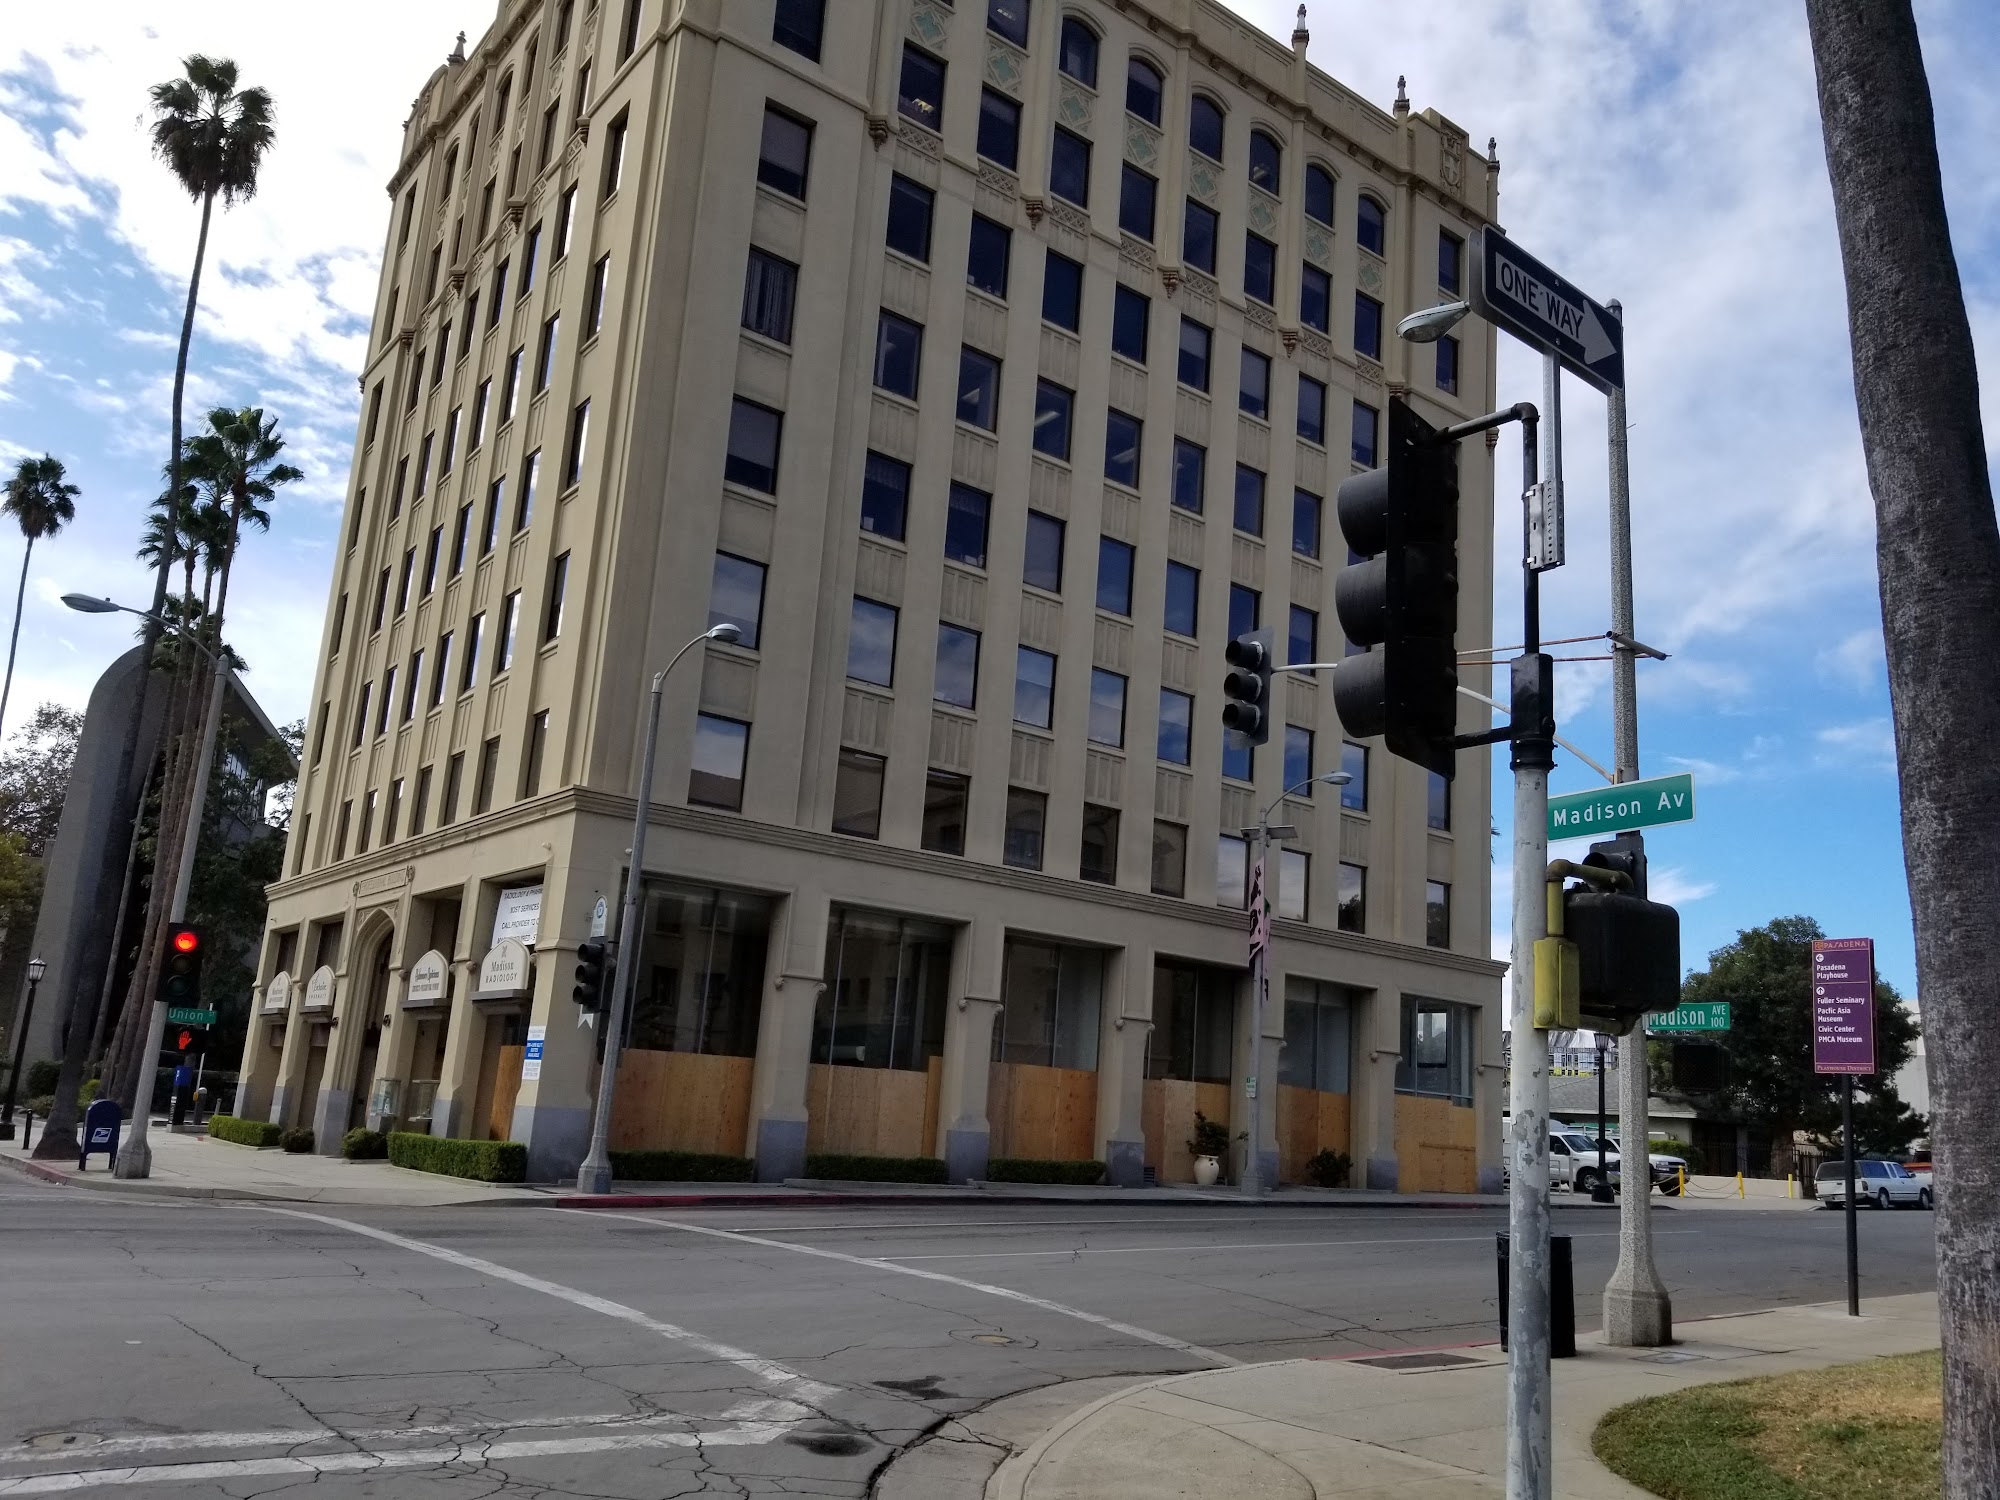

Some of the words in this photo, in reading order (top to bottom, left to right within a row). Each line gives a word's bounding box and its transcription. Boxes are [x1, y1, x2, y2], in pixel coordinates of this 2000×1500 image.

[1501, 262, 1539, 312] ONE
[1546, 291, 1584, 339] WAY
[1553, 800, 1641, 827] Madison
[1657, 792, 1685, 811] Av
[1824, 941, 1866, 949] PASADENA
[491, 961, 514, 972] Madison
[1816, 964, 1846, 972] Pasadena
[485, 972, 518, 983] RADIOLOGY
[1816, 972, 1849, 981] Playhouse
[1836, 996, 1865, 1005] Seminary
[168, 1008, 204, 1021] Union
[1711, 1004, 1726, 1016] AVE
[1817, 1007, 1836, 1015] Pacific
[1649, 1008, 1705, 1025] Madison
[1710, 1016, 1725, 1028] 100
[1818, 1025, 1833, 1033] Civic
[1834, 1025, 1855, 1033] Center
[1836, 1035, 1863, 1043] Museum
